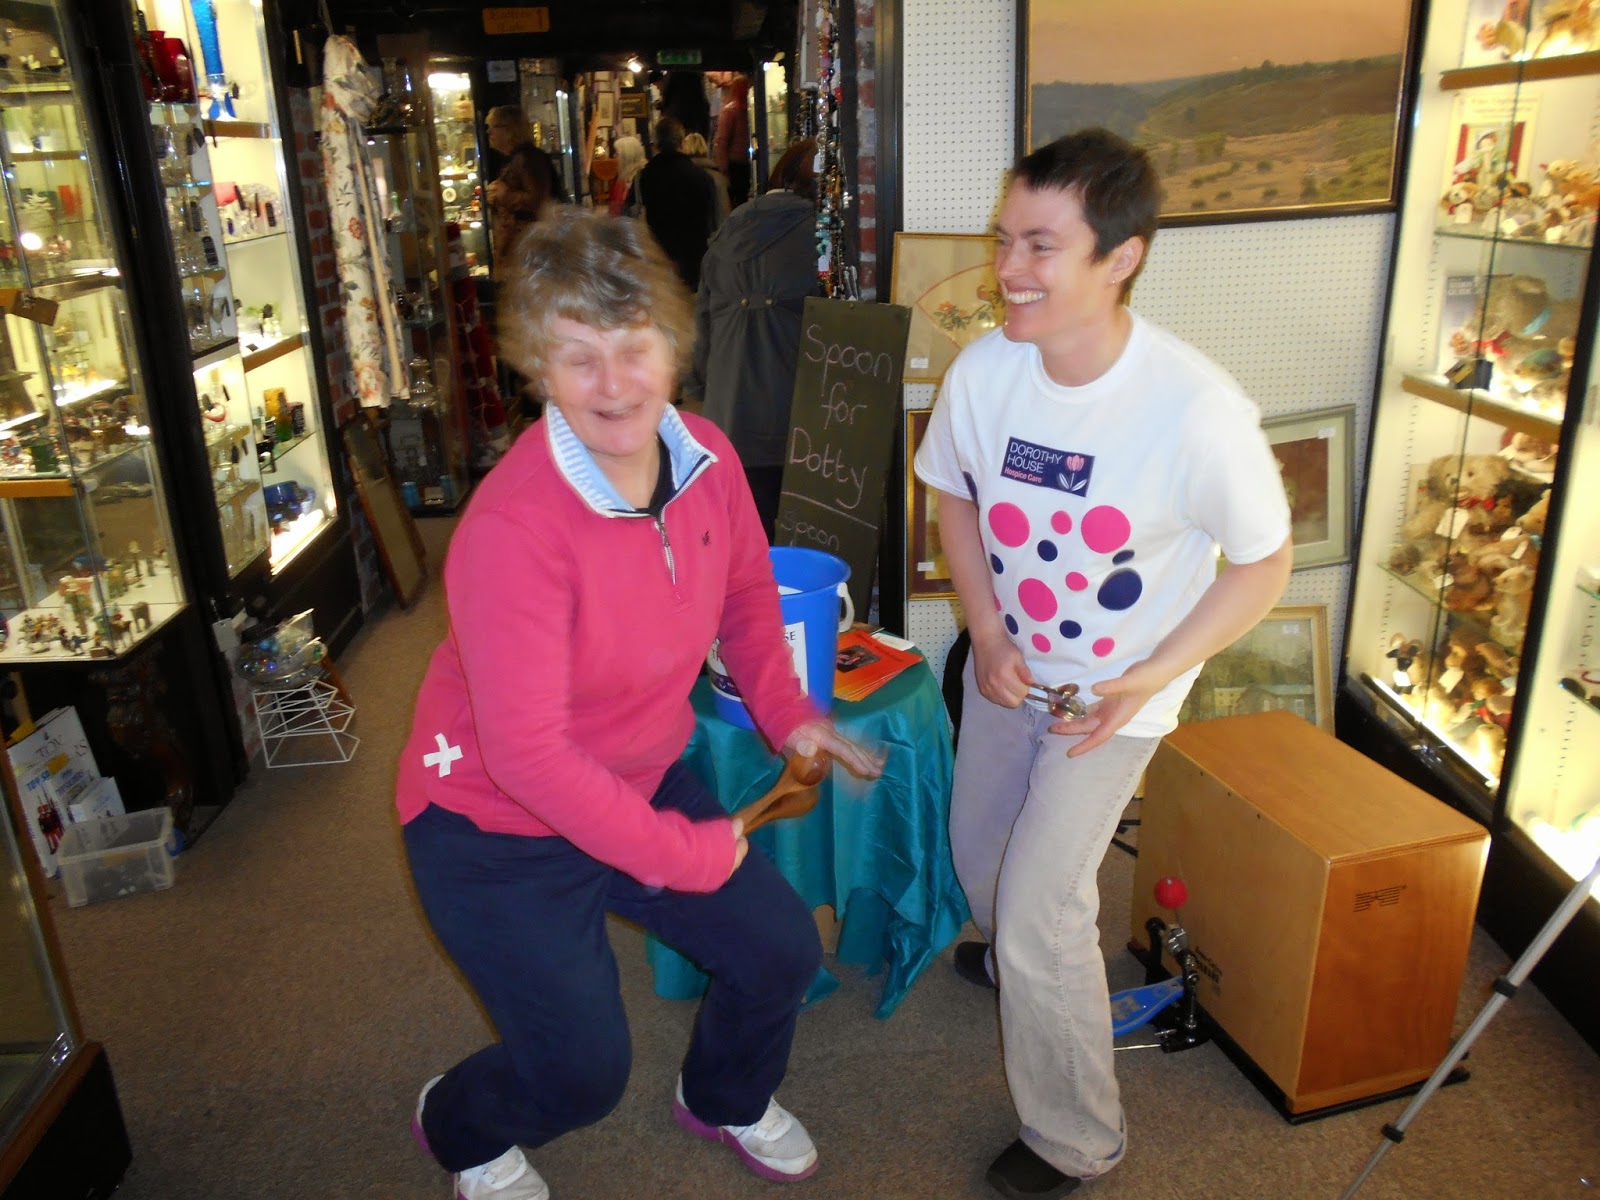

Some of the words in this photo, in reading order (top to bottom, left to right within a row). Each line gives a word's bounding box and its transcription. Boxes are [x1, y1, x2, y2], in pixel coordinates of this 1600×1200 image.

[805, 324, 893, 397] Spoon
[821, 382, 867, 429] for
[789, 427, 868, 509] Dotty
[1006, 454, 1044, 473] HOUSE
[1009, 441, 1062, 464] DOROTHY
[1004, 467, 1027, 480] Hospice
[1028, 474, 1042, 483] Care
